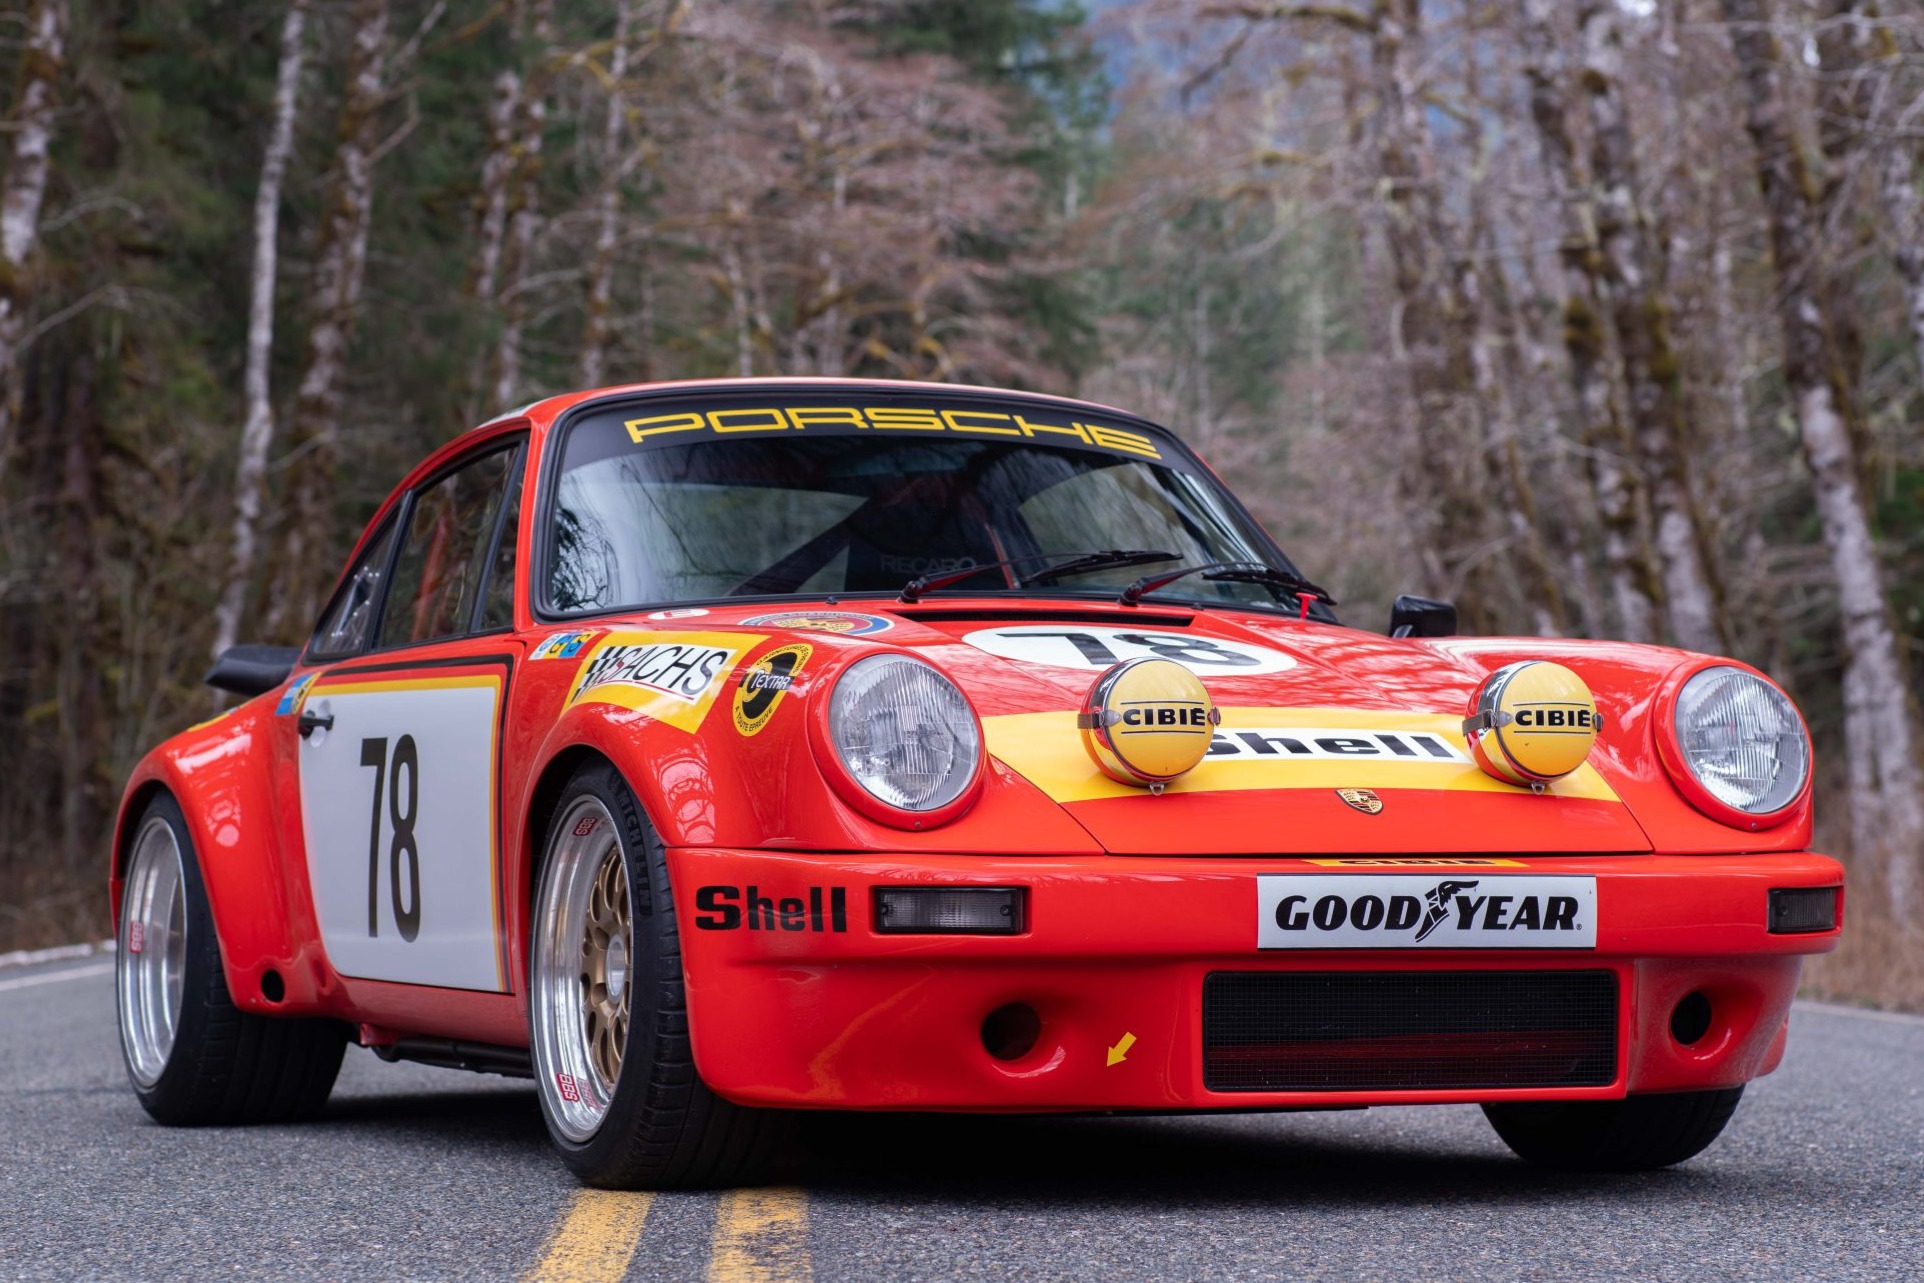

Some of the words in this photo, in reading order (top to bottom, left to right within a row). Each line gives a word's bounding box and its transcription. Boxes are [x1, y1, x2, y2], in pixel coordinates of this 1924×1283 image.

[624, 407, 1162, 460] PORSCHE
[880, 553, 978, 575] RECARO
[600, 645, 728, 695] SACHS
[996, 632, 1262, 666] 78
[360, 733, 422, 943] 78
[695, 885, 848, 933] Shell
[557, 1073, 580, 1102] BBS
